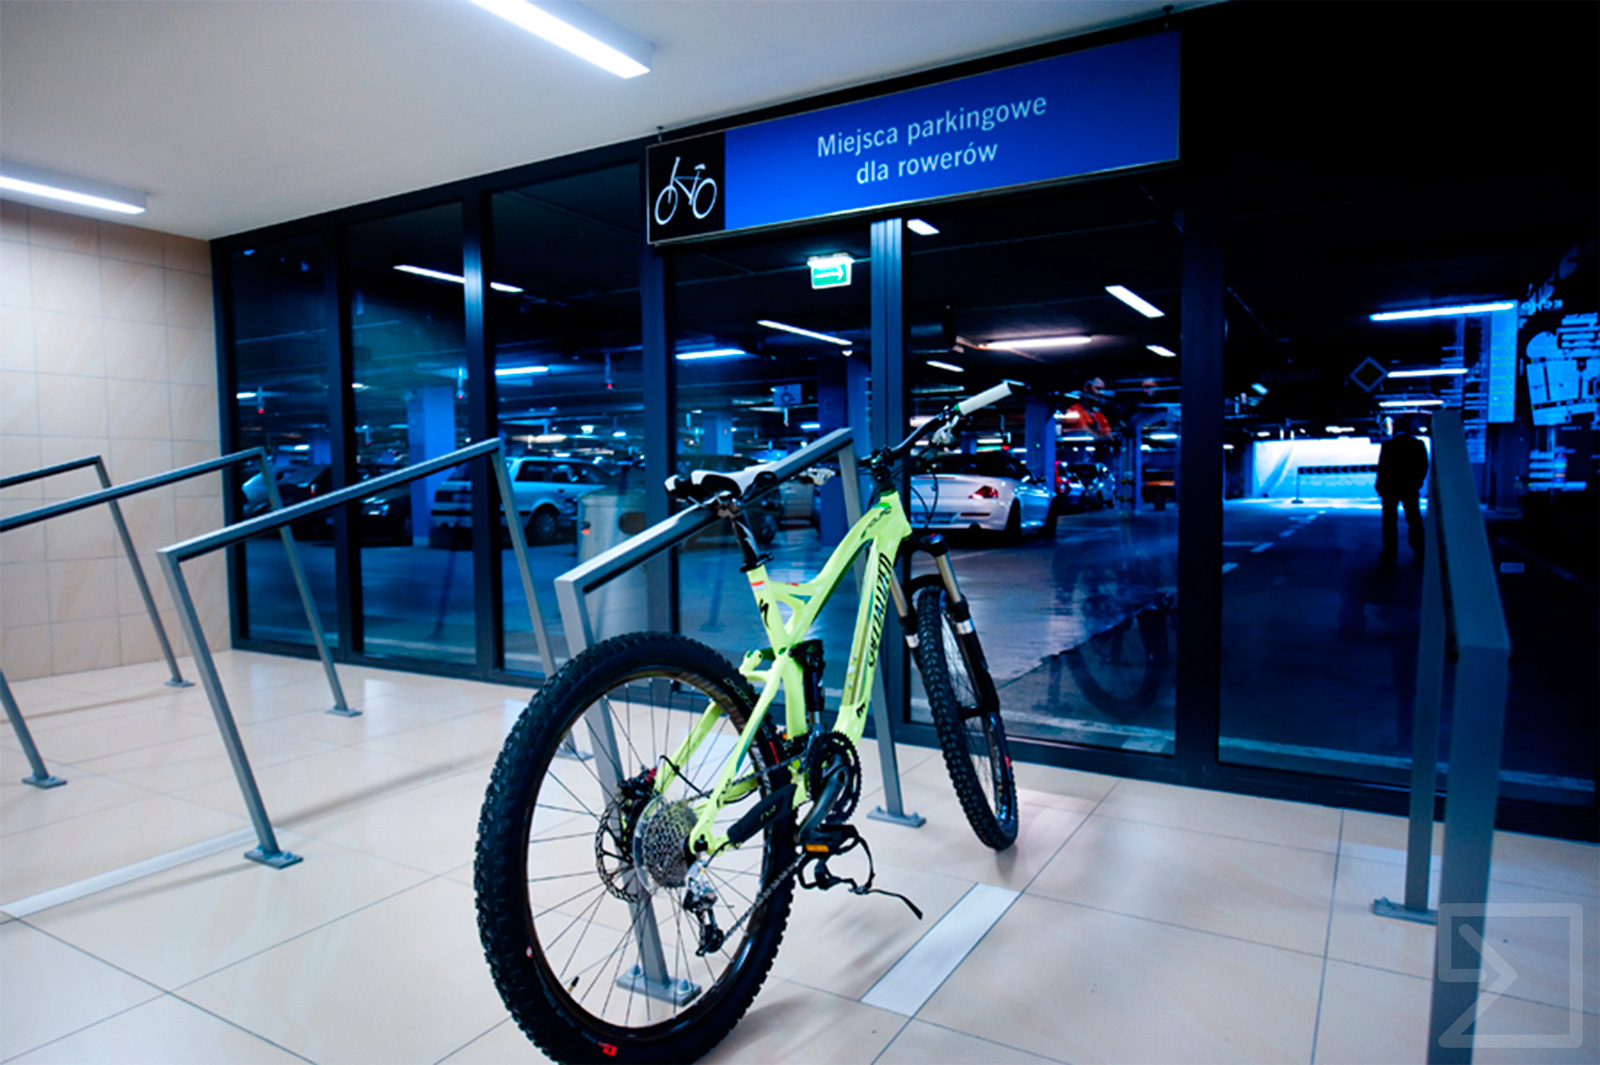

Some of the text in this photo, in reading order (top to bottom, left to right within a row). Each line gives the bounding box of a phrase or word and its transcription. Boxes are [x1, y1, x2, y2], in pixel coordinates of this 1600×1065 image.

[817, 96, 1047, 158] Miejsca parkingowe
[856, 141, 998, 184] dla rowerów
